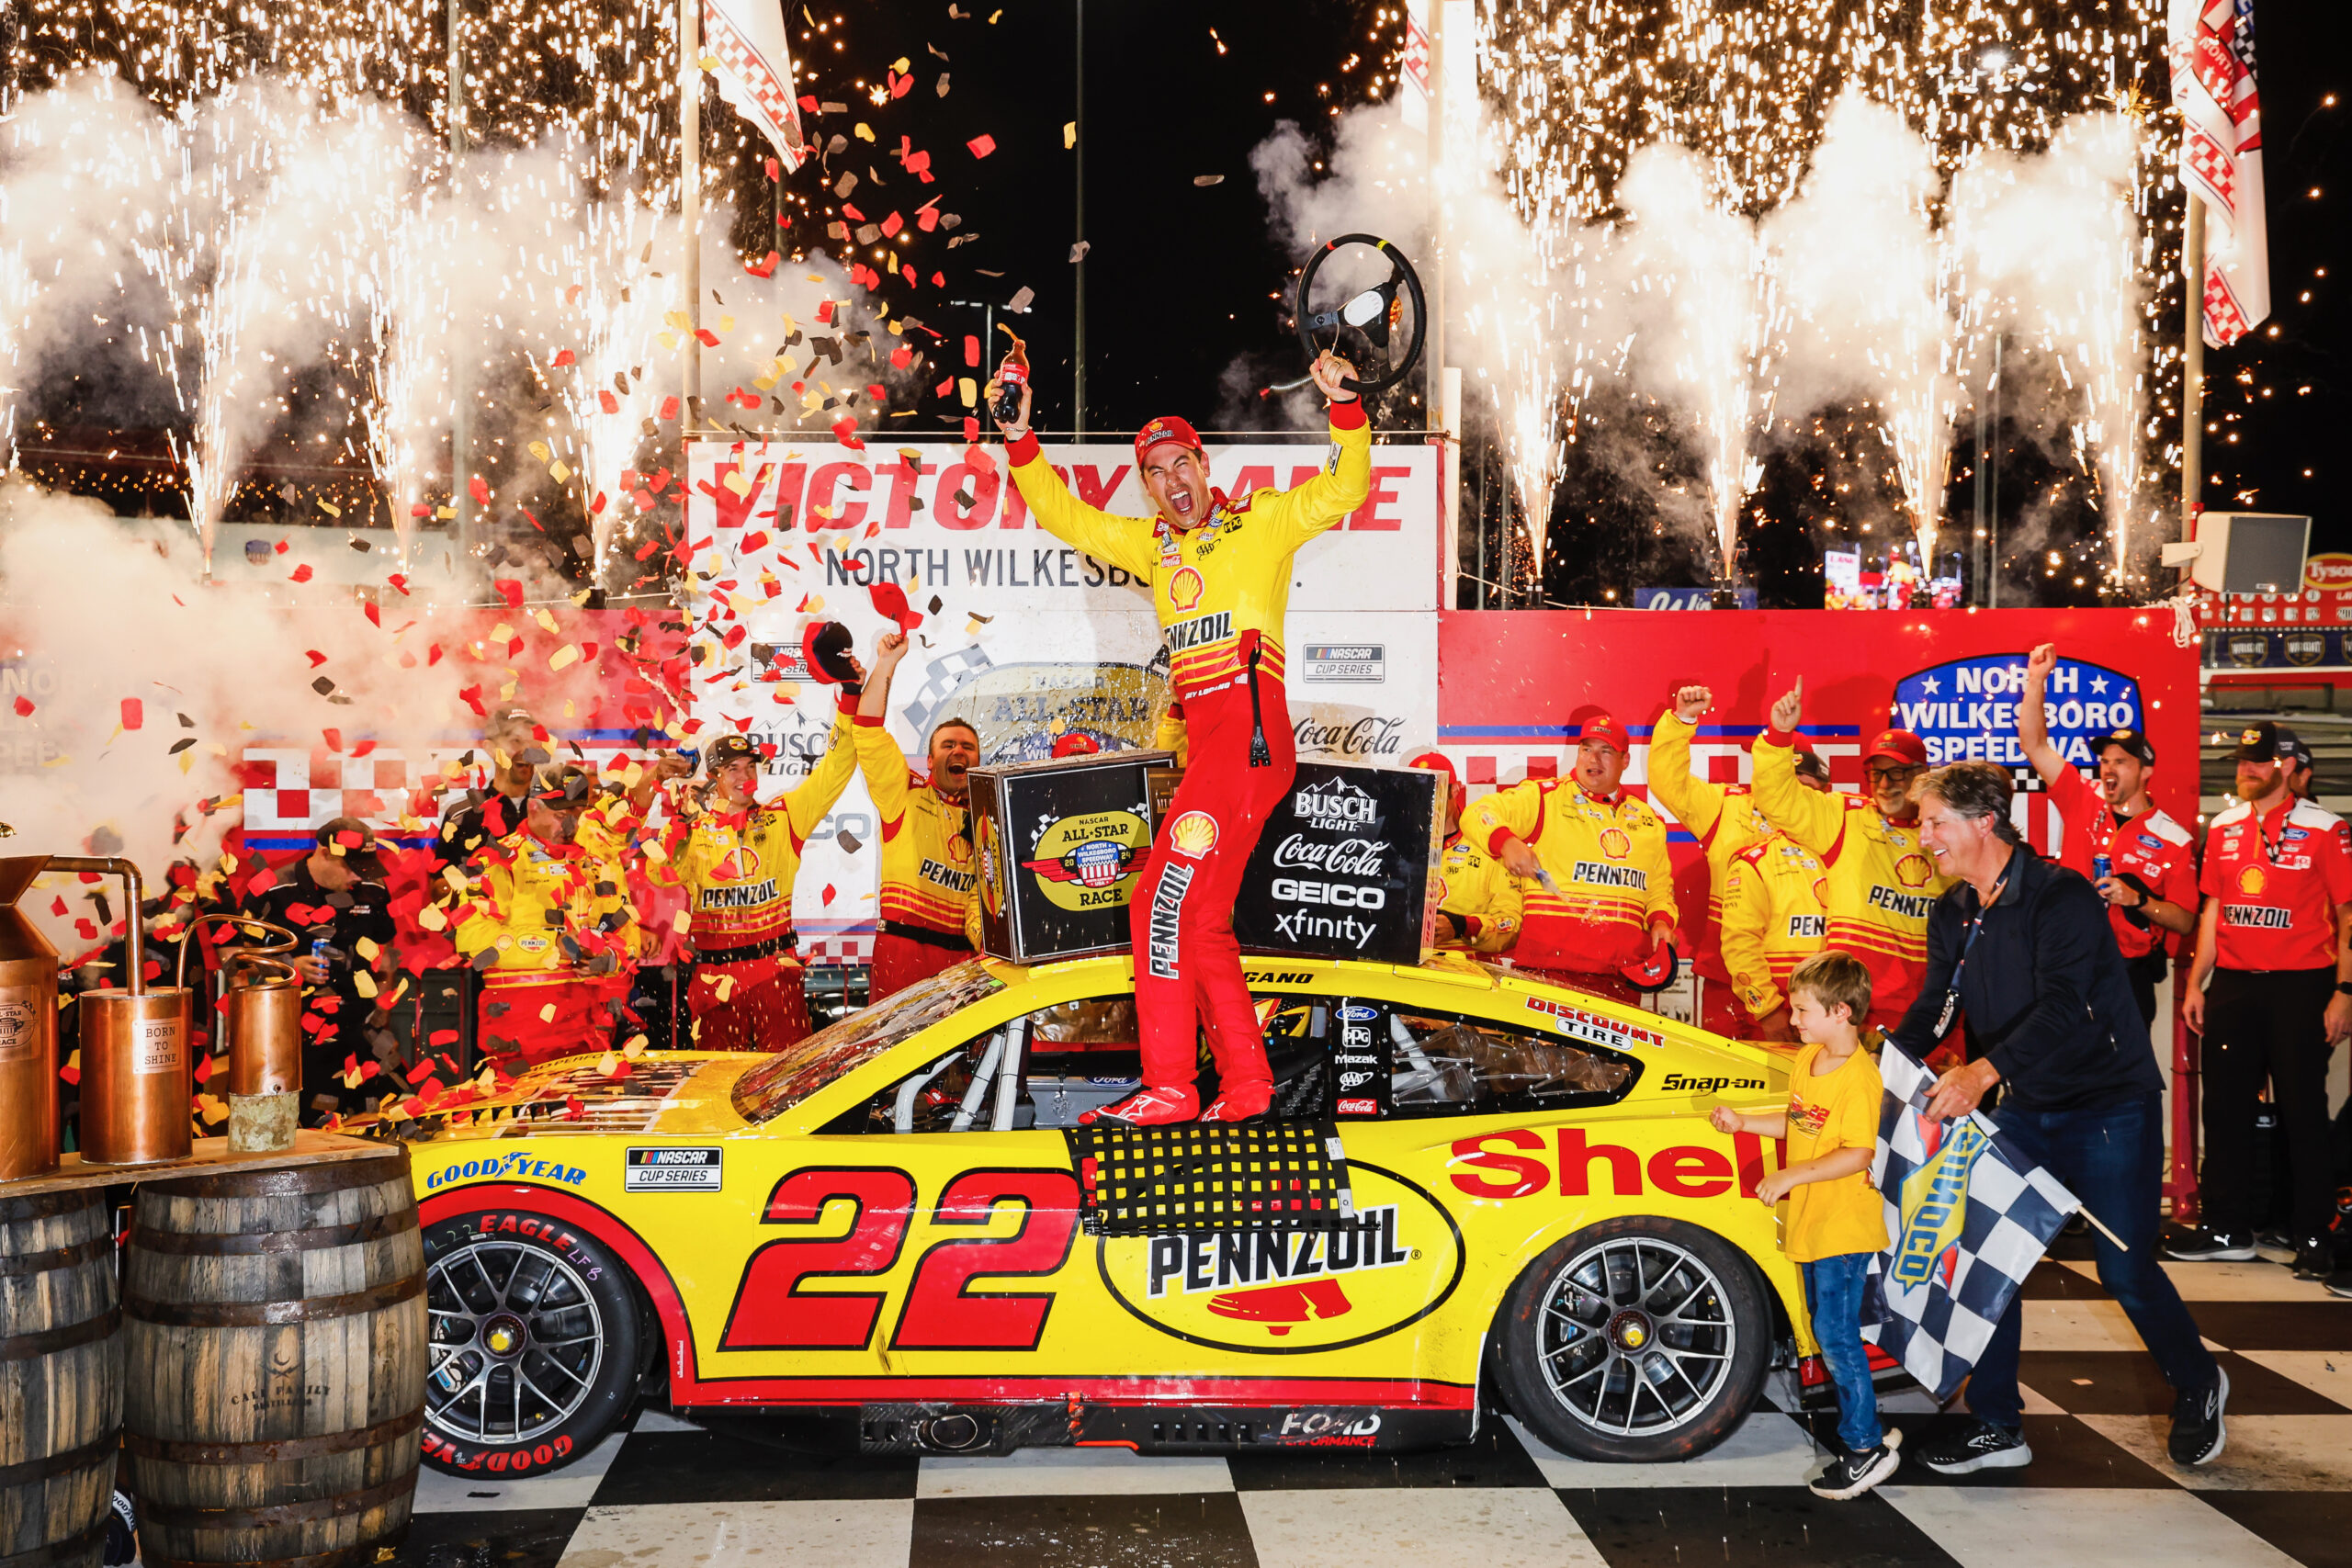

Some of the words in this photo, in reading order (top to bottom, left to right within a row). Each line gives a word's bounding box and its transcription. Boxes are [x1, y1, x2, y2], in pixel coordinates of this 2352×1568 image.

[1225, 517, 1242, 533] PPG
[827, 548, 949, 587] NORTH
[1329, 648, 1374, 660] NASCAR
[1316, 664, 1337, 675] CUP
[1337, 664, 1373, 675] SERIES
[1036, 676, 1105, 690] NASCAR
[1294, 716, 1408, 755] Coca-Cola
[1294, 792, 1378, 825] BUSCH
[1079, 816, 1109, 826] NASCAR
[1077, 847, 1117, 859] WILKESBORO
[1086, 842, 1108, 851] NORTH
[1081, 853, 1114, 863] SPEEDWAY
[1121, 851, 1132, 860] 24
[1273, 833, 1390, 877] Coca-Cola
[1064, 859, 1075, 867] 20
[1572, 861, 1647, 892] PENNZOIL
[702, 878, 780, 909] PENNZOIL
[1080, 888, 1124, 907] RACE
[1272, 878, 1385, 909] GEICO
[1150, 860, 1195, 980] PENNZOIL
[1274, 908, 1377, 950] xfinity
[1244, 971, 1315, 984] GANO
[1344, 1008, 1369, 1020] Ford
[1525, 996, 1666, 1048] DISCOUNT
[145, 1026, 175, 1038] BORN
[1346, 1029, 1370, 1044] PPG
[1565, 1021, 1623, 1047] TIRE
[154, 1041, 169, 1051] TO
[144, 1053, 177, 1066] SHINE
[1335, 1055, 1378, 1065] Mazak
[1341, 1073, 1363, 1087] AAA
[1661, 1073, 1766, 1093] Snap-on
[1338, 1100, 1374, 1113] Coca-Cola
[656, 1151, 708, 1164] NASCAR
[427, 1152, 587, 1190] GOODYEAR
[639, 1169, 663, 1181] CUP
[665, 1169, 707, 1181] SERIES
[479, 1214, 578, 1252] EAGLE
[717, 1166, 1084, 1352] 22
[1146, 1203, 1413, 1301] PENNZOIL
